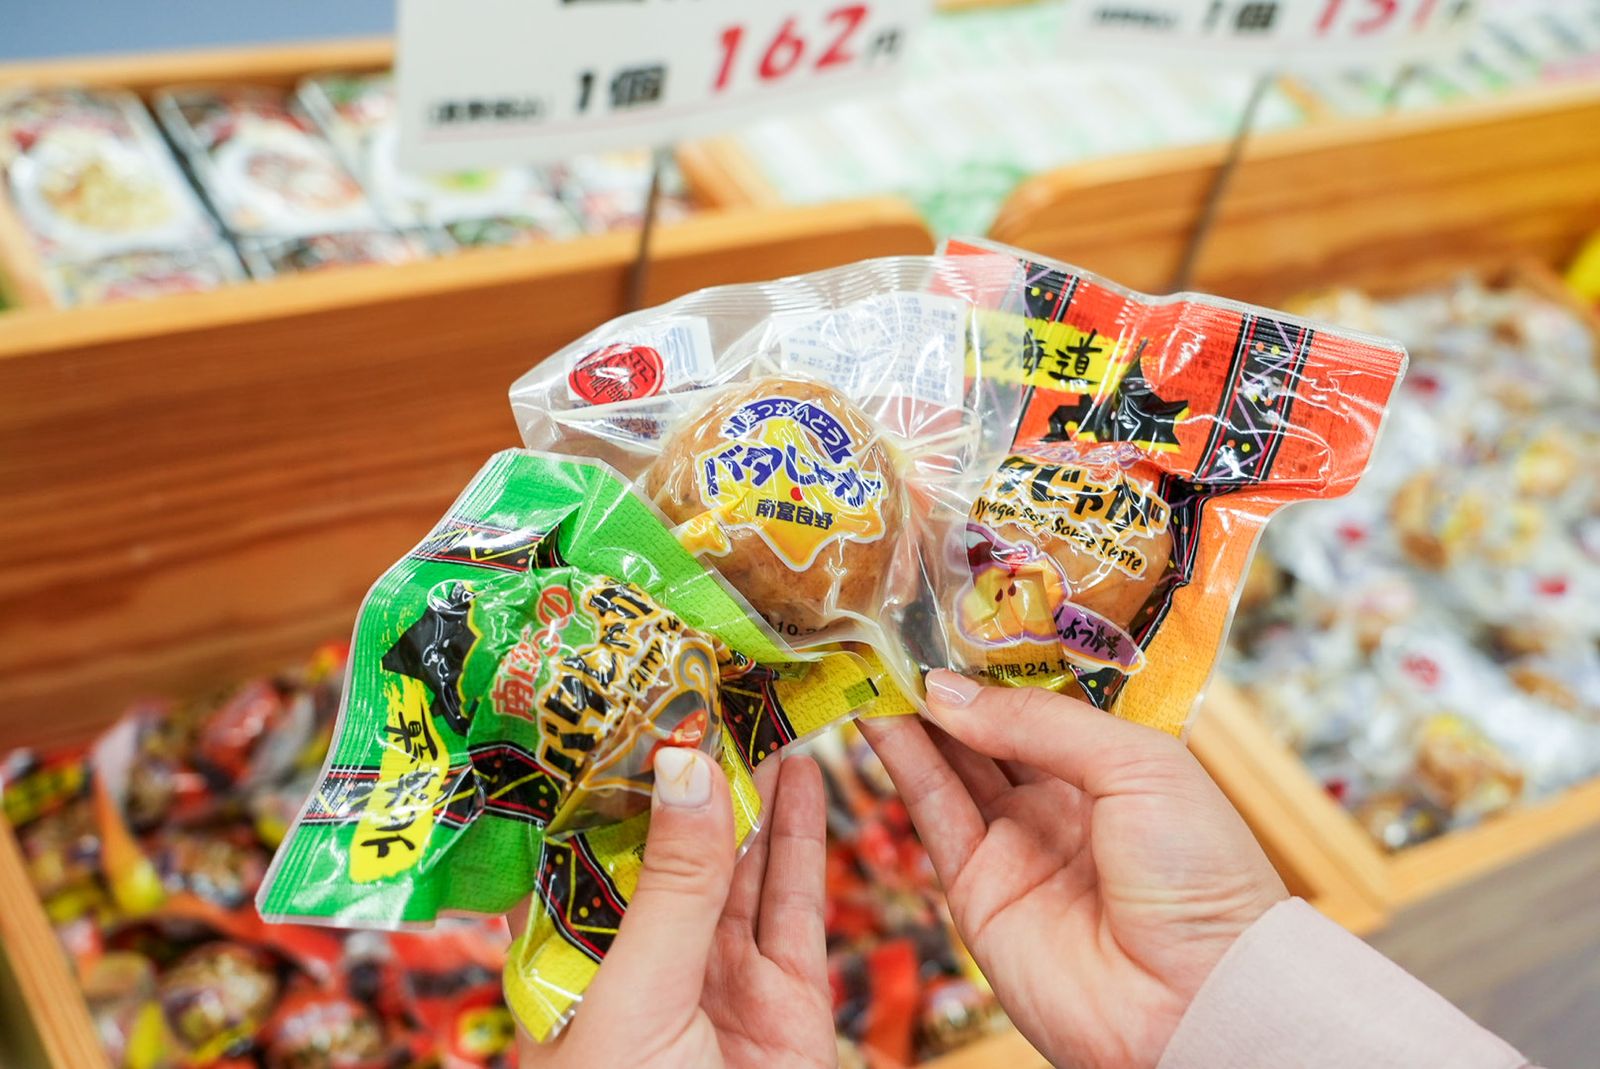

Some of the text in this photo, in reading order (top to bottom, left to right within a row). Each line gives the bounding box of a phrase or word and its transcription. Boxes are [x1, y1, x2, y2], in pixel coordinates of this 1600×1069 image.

[743, 400, 843, 447] ほっかいどう
[755, 498, 834, 531] 南富良野
